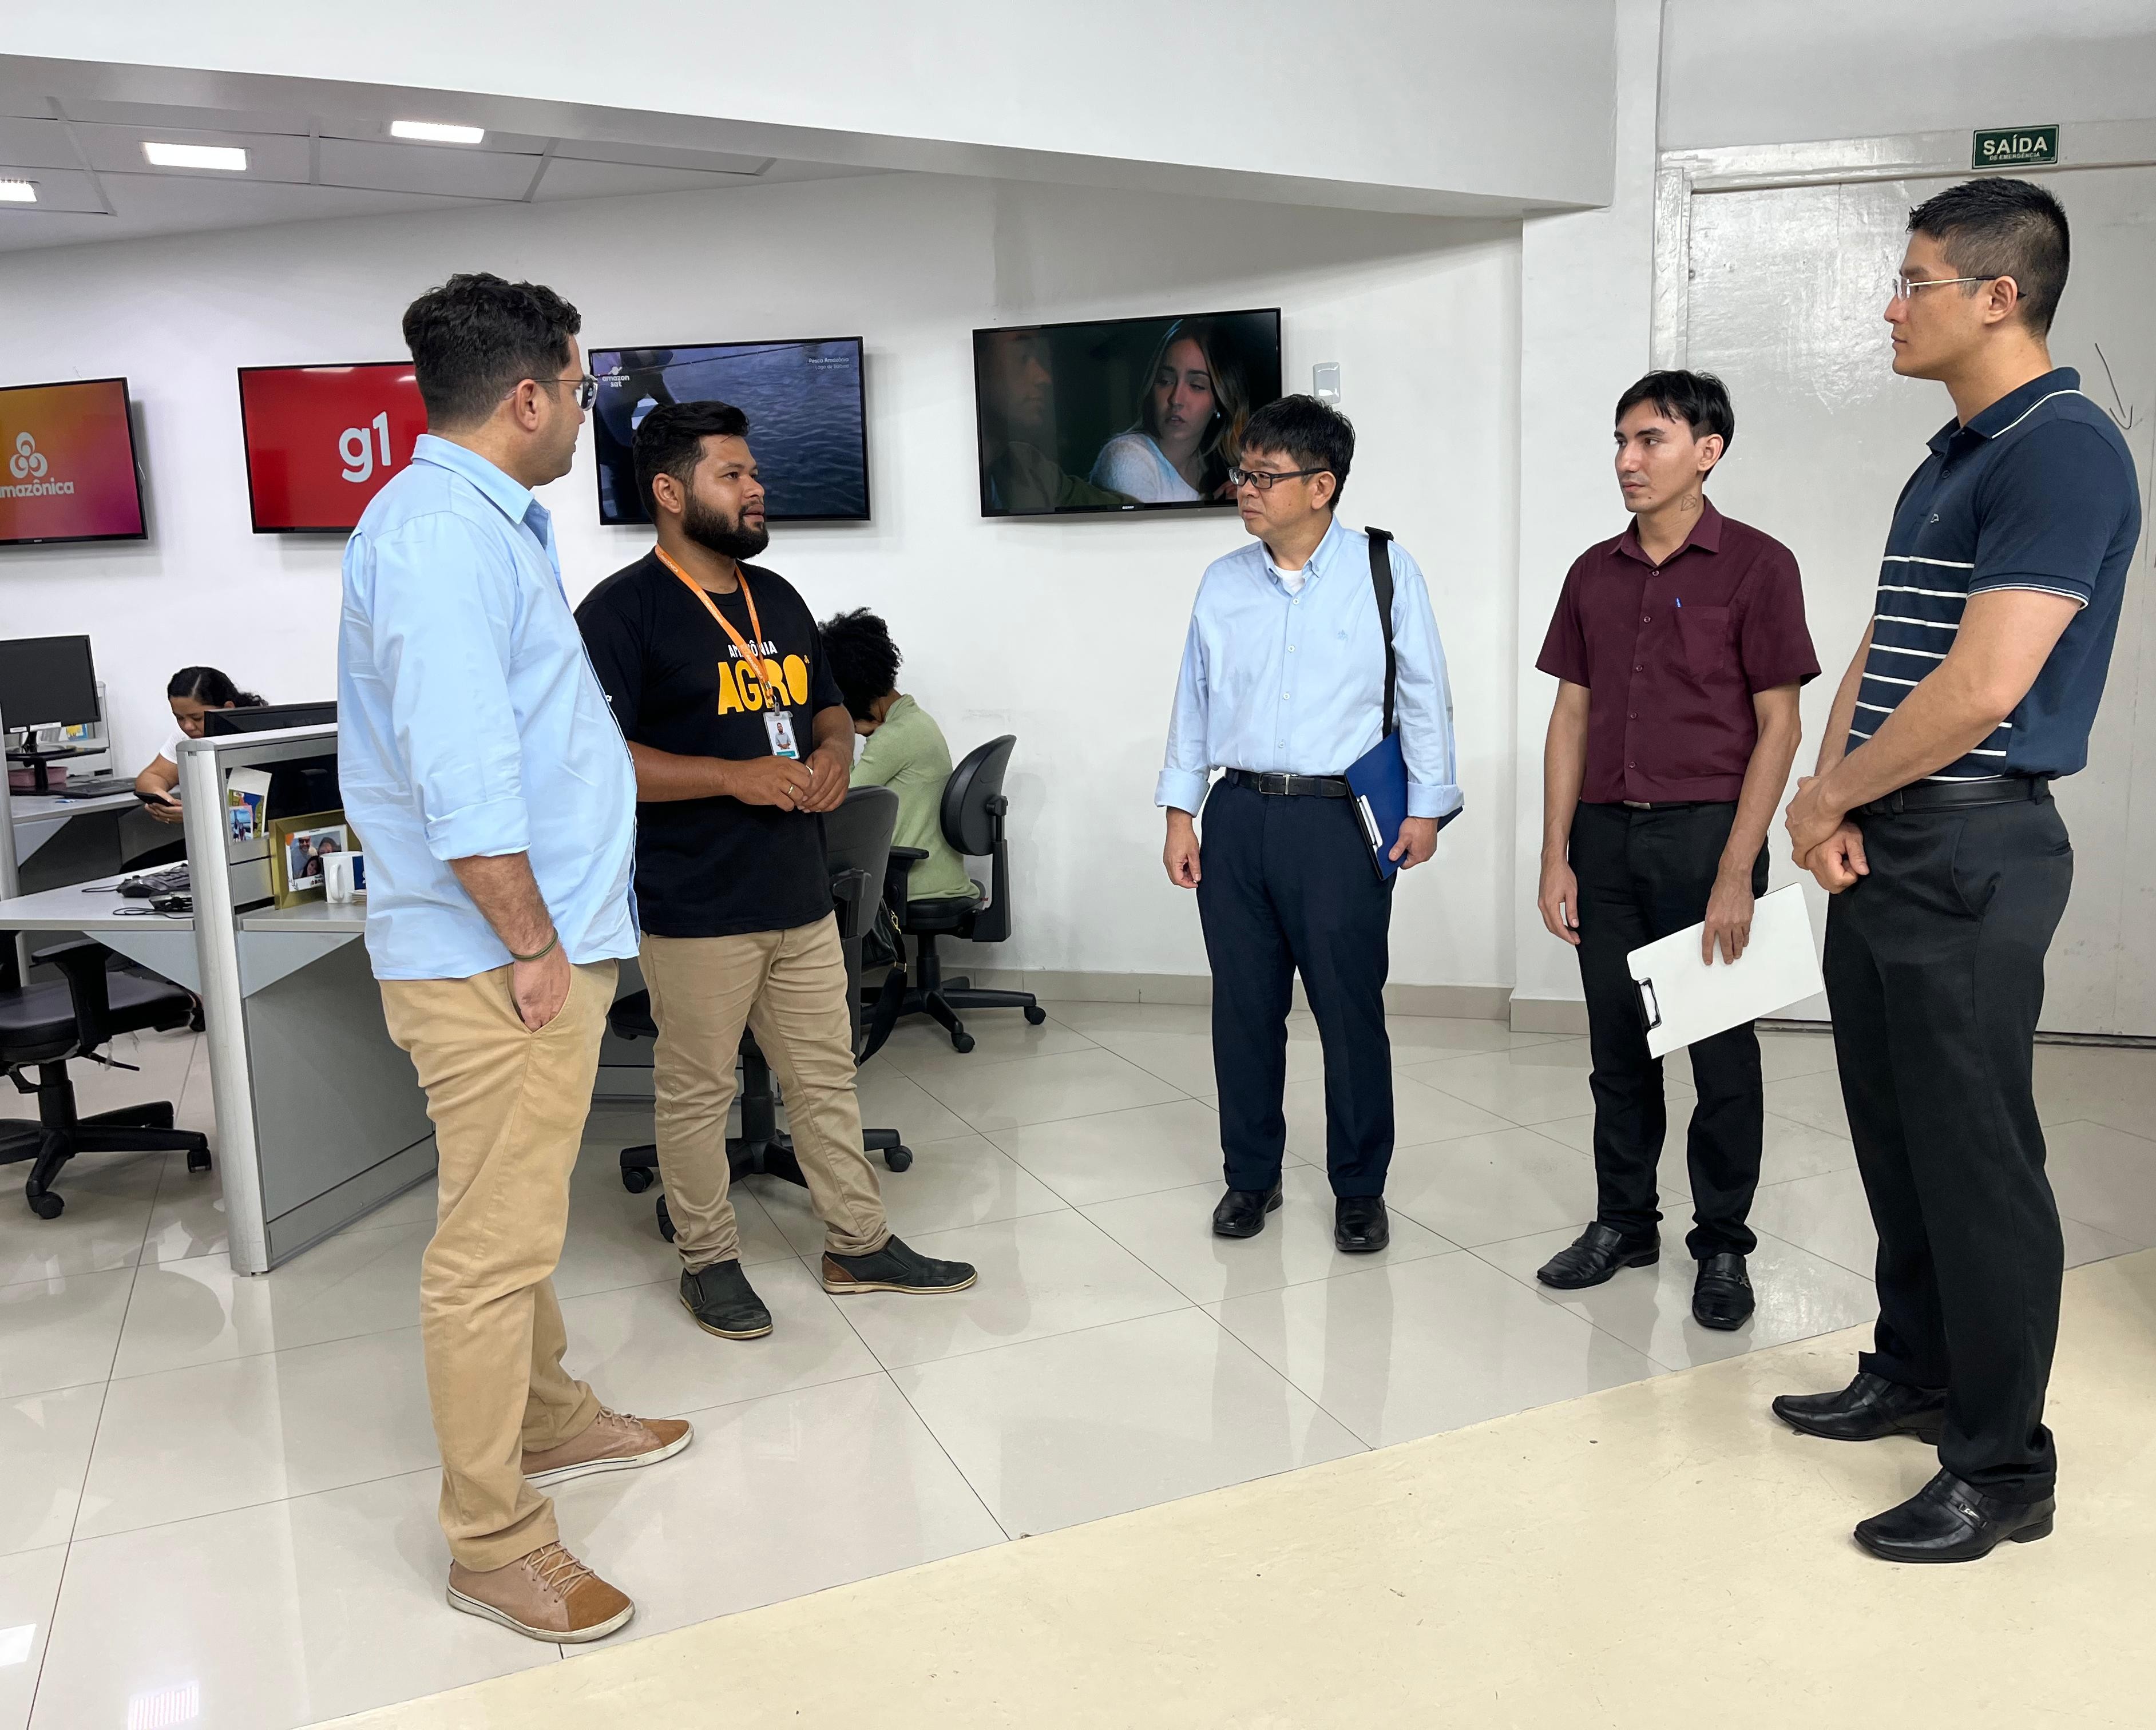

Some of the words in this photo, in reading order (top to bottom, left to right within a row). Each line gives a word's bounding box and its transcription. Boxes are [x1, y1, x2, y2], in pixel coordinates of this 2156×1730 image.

[1983, 134, 2048, 156] SAÍDA
[339, 411, 391, 483] g1
[0, 477, 74, 498] mazônica
[728, 640, 778, 658] AMÔNIA
[718, 654, 808, 715] AGRO
